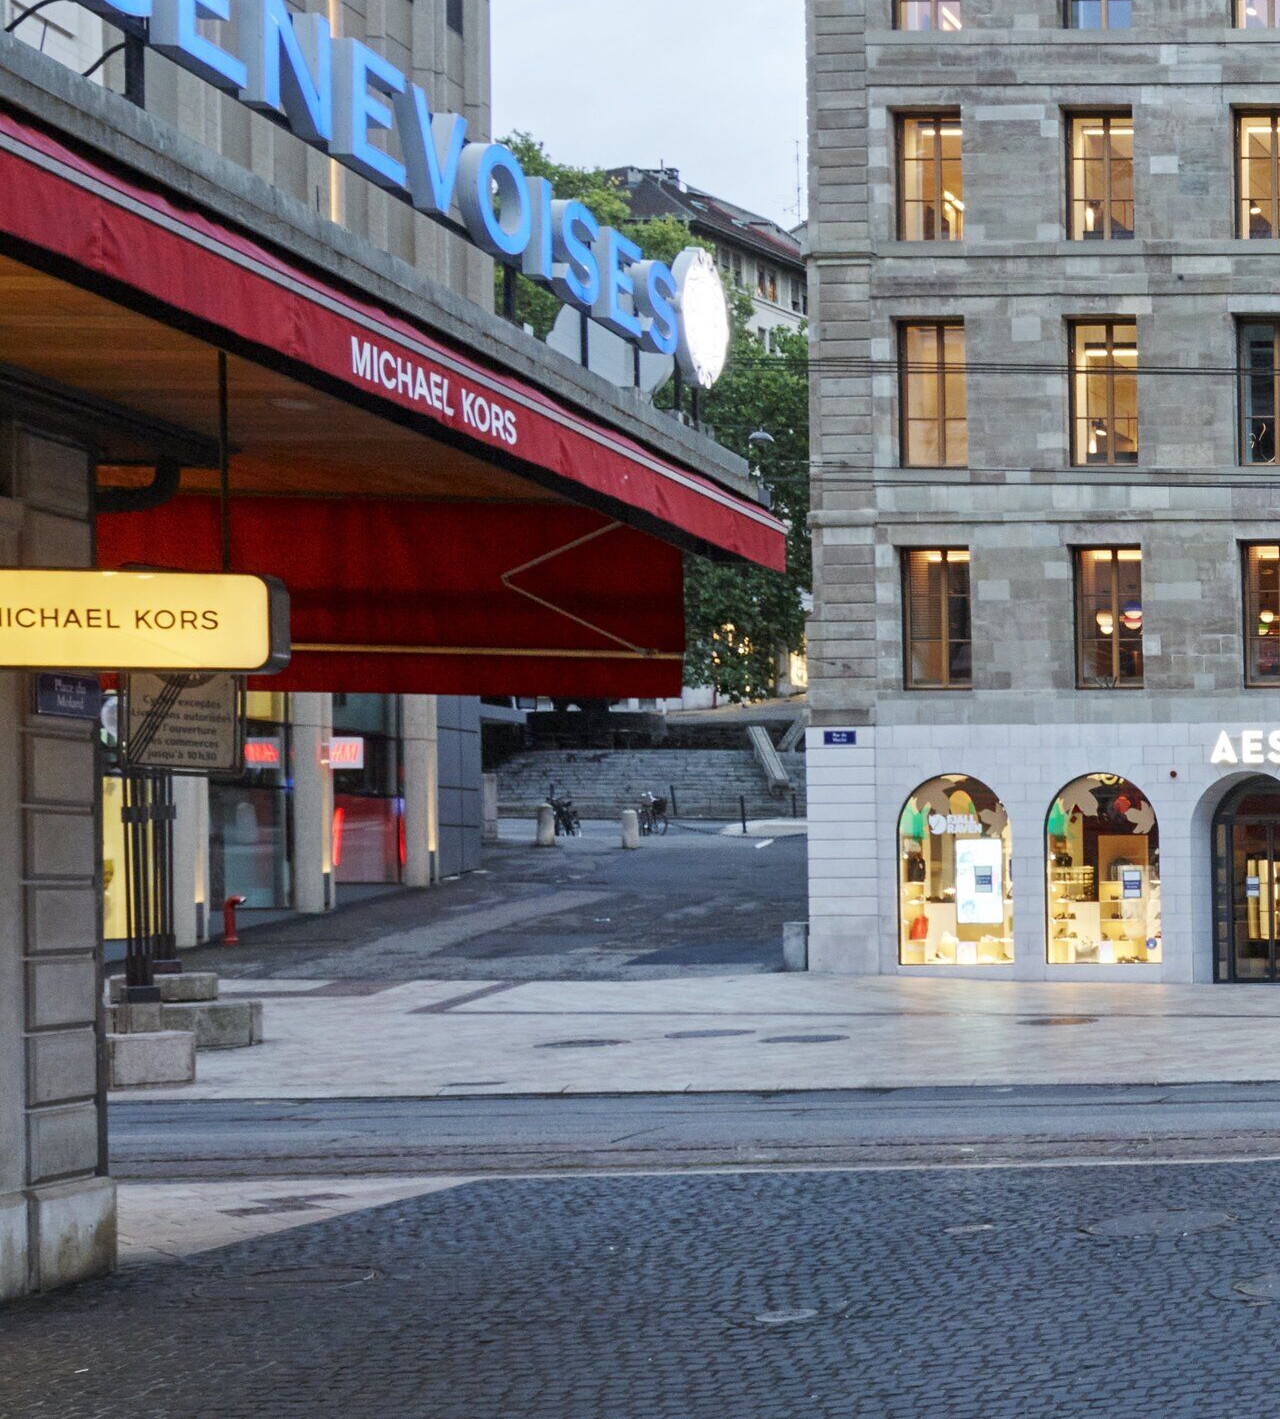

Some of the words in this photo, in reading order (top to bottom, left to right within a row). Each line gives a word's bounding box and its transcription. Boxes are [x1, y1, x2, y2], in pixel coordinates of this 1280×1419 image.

[351, 336, 454, 417] MICHAEL
[461, 388, 518, 445] KORS
[0, 607, 120, 629] ICHAEL
[135, 609, 219, 630] KORS
